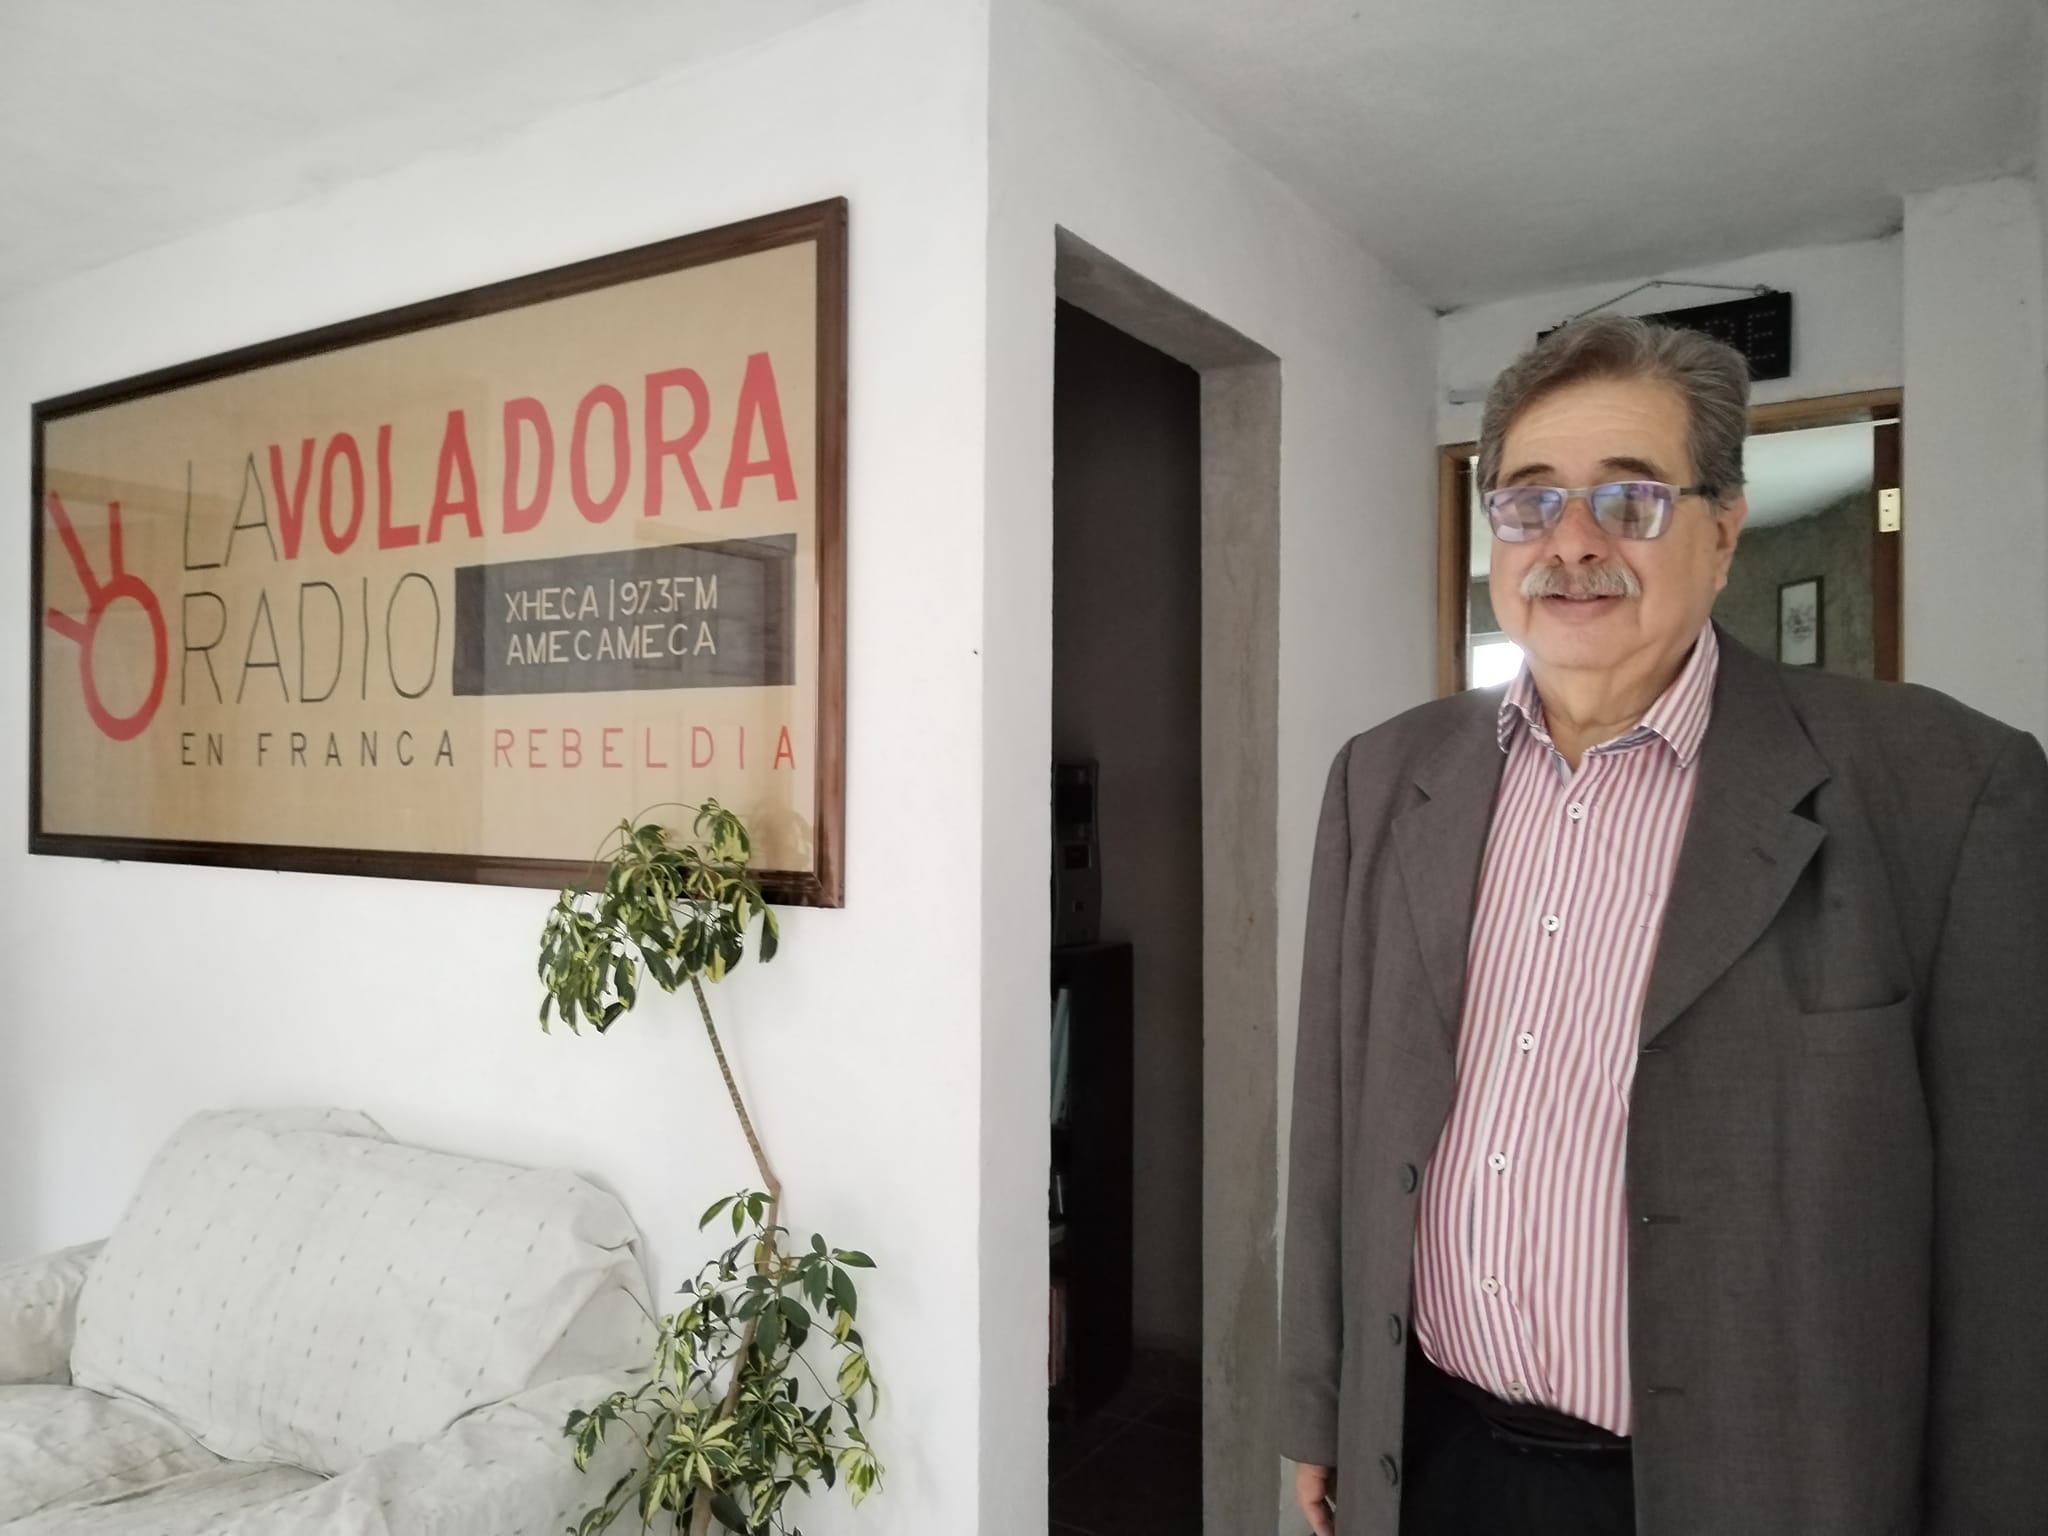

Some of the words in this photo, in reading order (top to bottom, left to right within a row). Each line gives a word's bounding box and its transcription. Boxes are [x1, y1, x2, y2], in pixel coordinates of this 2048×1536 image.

[184, 452, 277, 570] LA
[269, 351, 798, 560] VOLADORA
[504, 584, 599, 623] XHECA
[181, 572, 440, 705] RADIO
[506, 621, 718, 666] AMECAMECA
[181, 732, 223, 767] EN
[257, 729, 454, 767] FRANCA
[494, 725, 796, 770] REBELDIA
